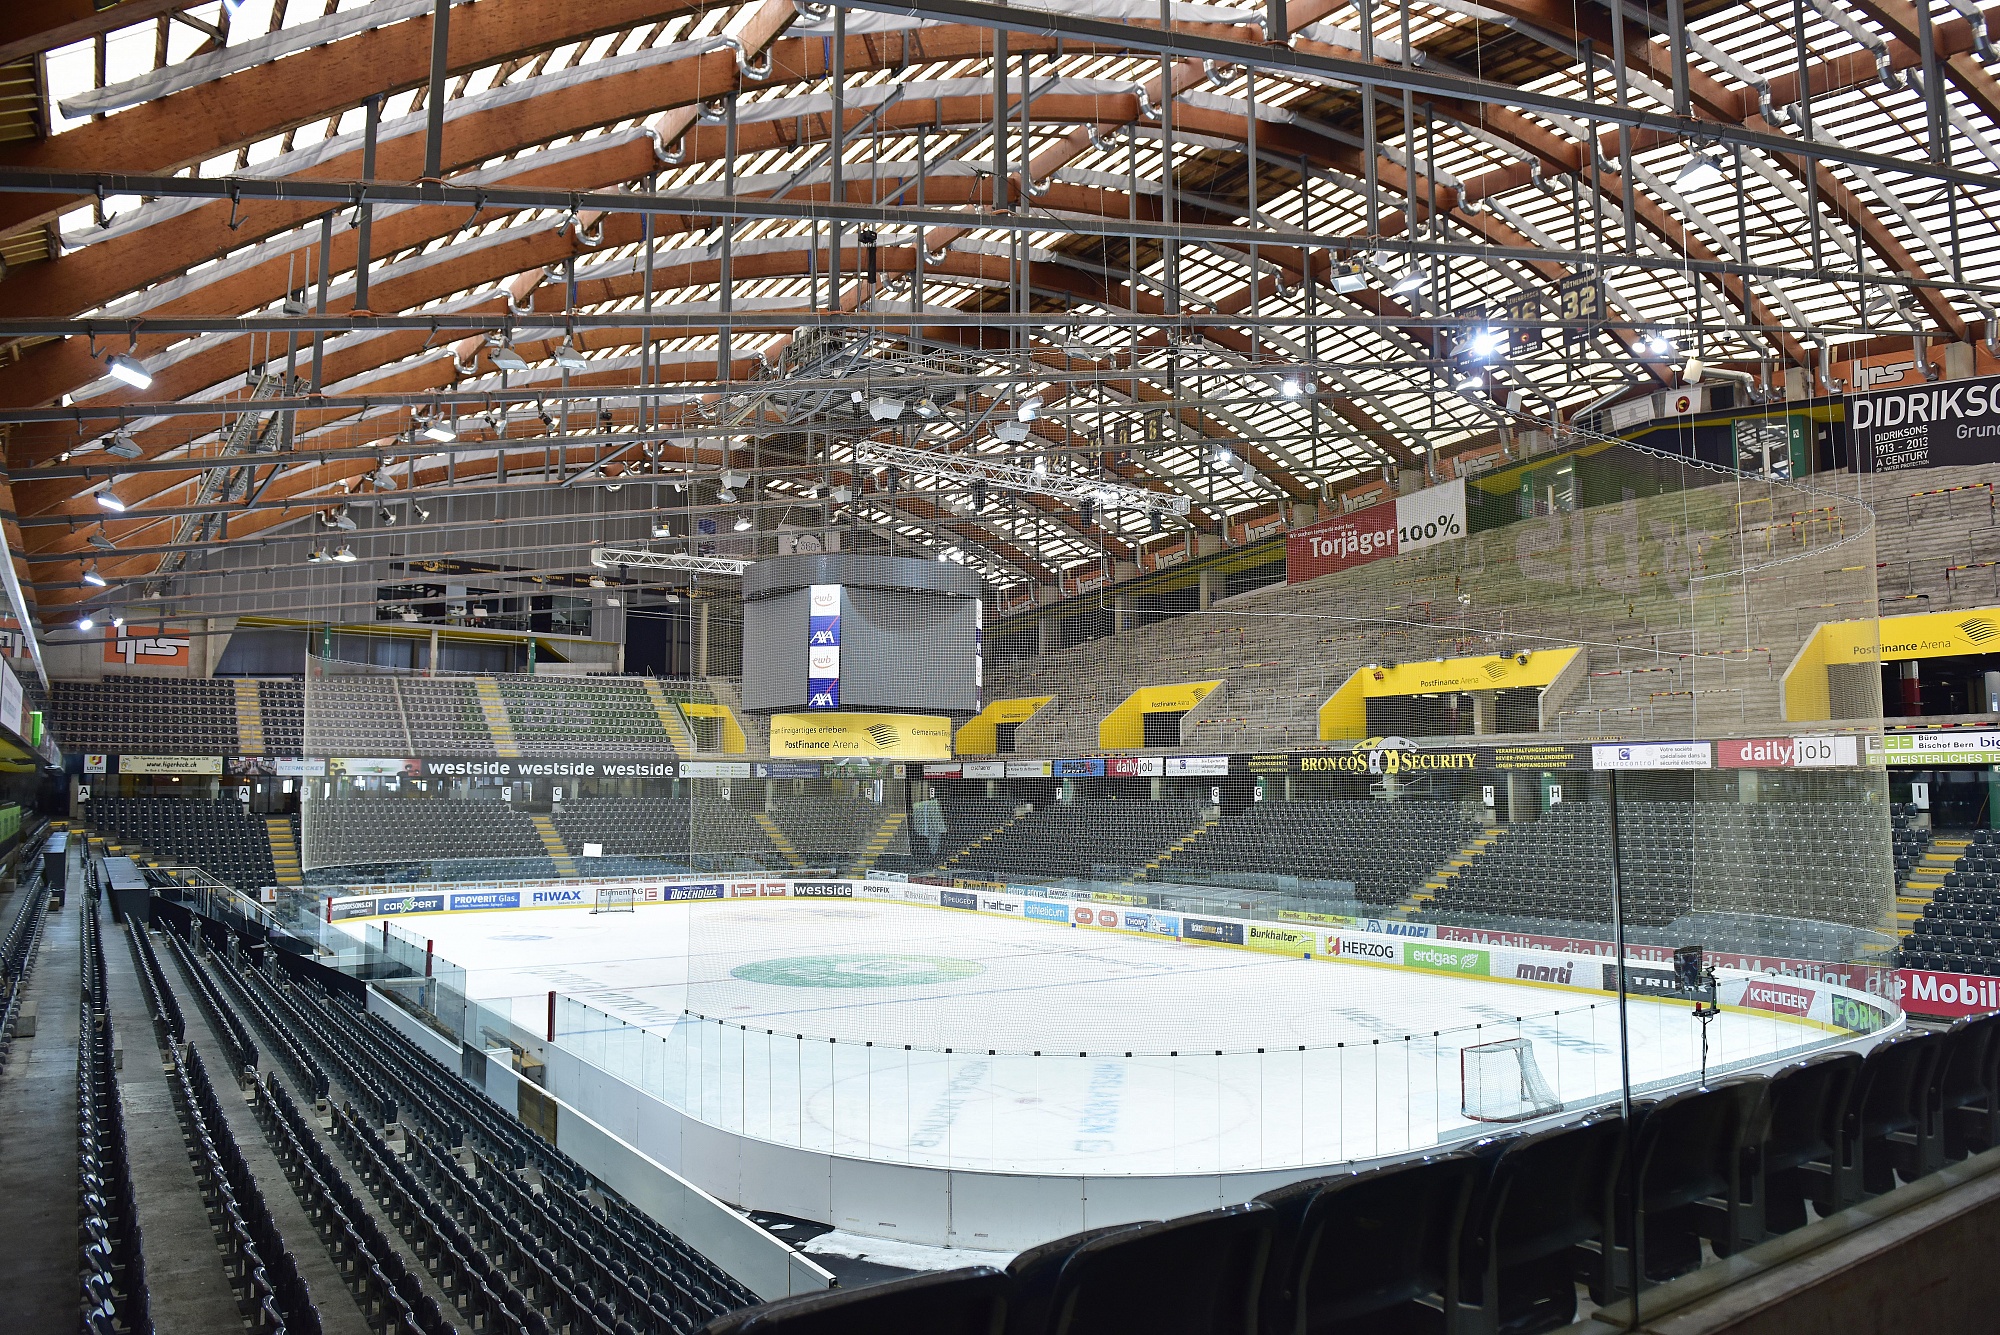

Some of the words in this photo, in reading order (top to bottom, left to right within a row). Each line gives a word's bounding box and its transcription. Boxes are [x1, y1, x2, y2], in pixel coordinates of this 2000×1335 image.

[1563, 285, 1596, 320] 32
[1853, 360, 1914, 391] hrs
[1875, 425, 1929, 443] DIDRIKSONS
[1956, 424, 2000, 440] Grun
[1875, 443, 1894, 456] 1913
[1906, 436, 1929, 450] 2013
[1452, 453, 1500, 478] hrs
[1876, 457, 1883, 468] A
[1885, 450, 1929, 466] CENTURY
[1399, 514, 1460, 544] 100%
[1309, 527, 1395, 558] Torjäger
[814, 593, 833, 602] ewb
[810, 630, 835, 644] AXA
[1920, 640, 1951, 649] Arena
[813, 655, 832, 664] ewb
[1420, 679, 1460, 688] PostFinance
[808, 693, 834, 706] AXA
[785, 740, 830, 749] PostFinance
[832, 740, 859, 749] Arena
[1301, 753, 1367, 772] BRONCOS
[1401, 752, 1477, 772] SECURITY
[1890, 753, 1983, 764] MEISTERLICHES
[428, 761, 510, 775] westside
[518, 762, 595, 776] westside
[602, 763, 674, 776] westside
[79, 786, 89, 796] A
[239, 787, 249, 796] A
[1485, 788, 1492, 798] H
[1551, 787, 1559, 797] H
[533, 890, 582, 902] RIWAX
[600, 889, 631, 897] Element
[795, 884, 852, 896] westside
[863, 885, 890, 894] PROFFIX
[498, 894, 518, 903] Glas.
[948, 896, 975, 906] PEUGEOT
[983, 899, 1018, 912] halter
[1027, 903, 1066, 917] athleticum
[1126, 917, 1147, 927] THOMY
[1250, 927, 1297, 943] Burkhalter
[1342, 941, 1394, 959] HERZOG
[1413, 949, 1458, 967] erdgas
[1516, 961, 1574, 984] marti
[1912, 974, 2000, 1008] Mobil
